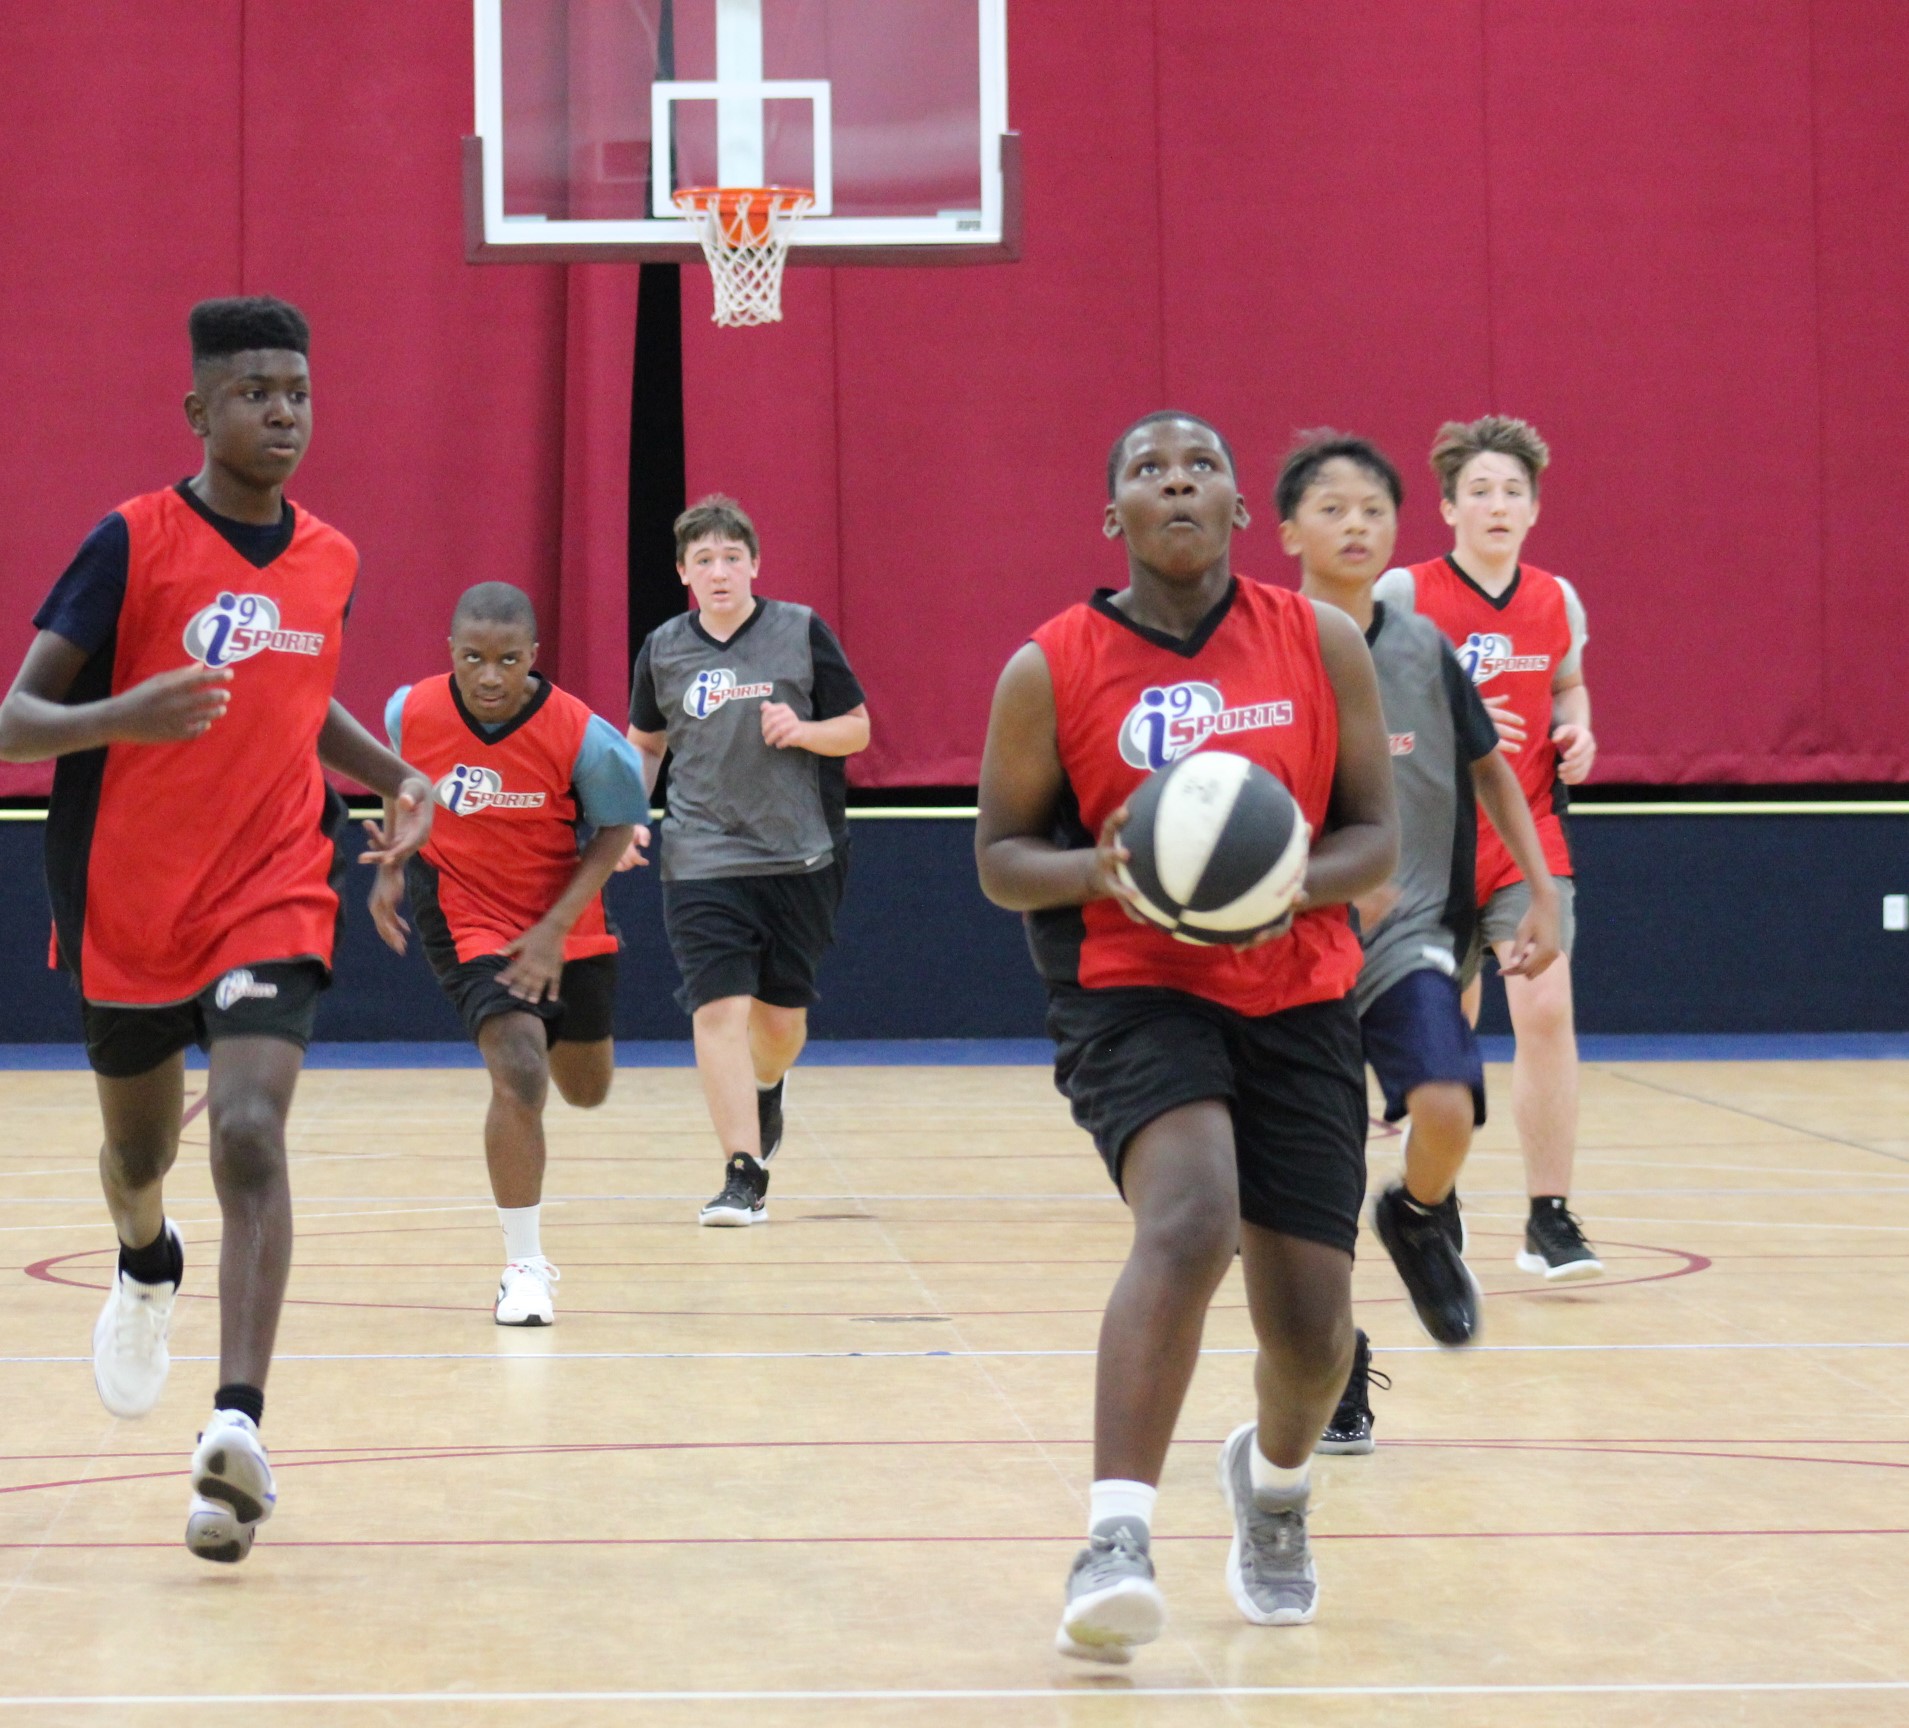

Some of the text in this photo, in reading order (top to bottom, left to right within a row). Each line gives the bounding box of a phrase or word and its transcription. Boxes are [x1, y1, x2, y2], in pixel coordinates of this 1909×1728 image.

[202, 594, 257, 666] i9
[228, 627, 323, 655] SPORTS
[1478, 657, 1548, 675] SPORTS
[690, 672, 722, 717] i9
[707, 684, 772, 705] SPORTS
[1134, 686, 1192, 769] i9
[1169, 701, 1292, 747] SPORTS
[463, 790, 545, 808] SPORTS
